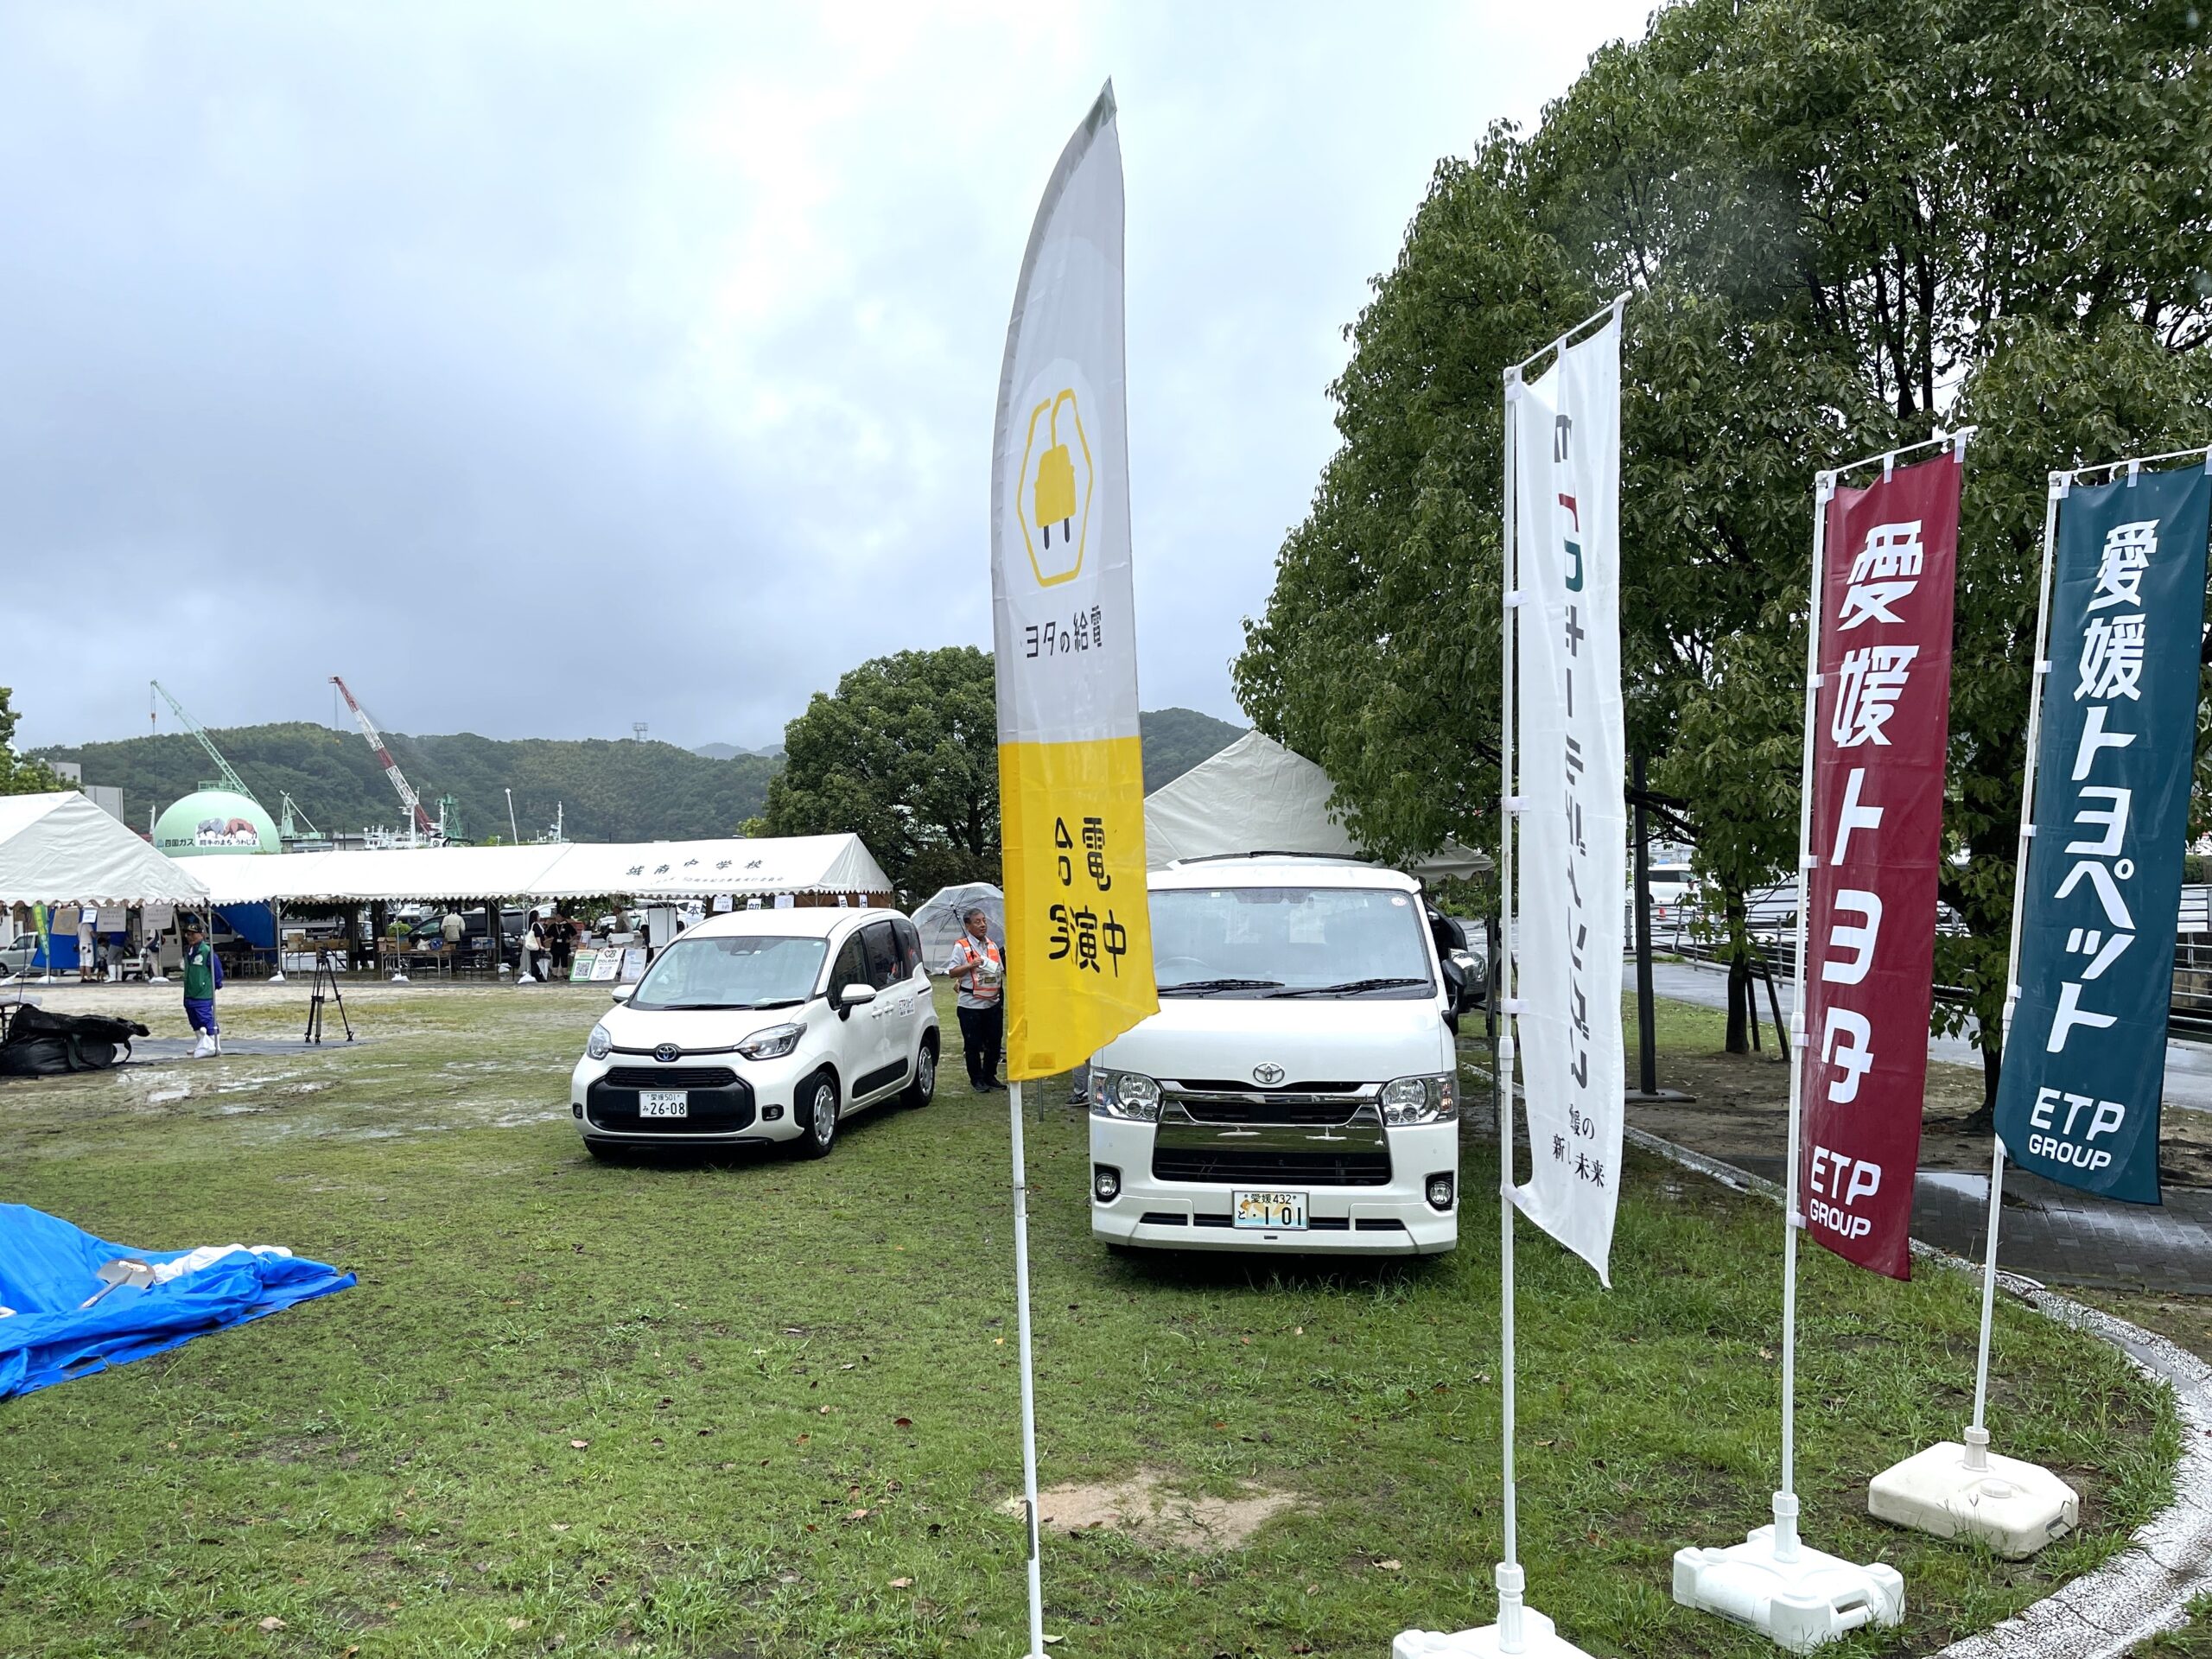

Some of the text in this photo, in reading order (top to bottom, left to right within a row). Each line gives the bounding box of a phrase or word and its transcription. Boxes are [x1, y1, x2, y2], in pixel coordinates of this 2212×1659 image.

[1025, 605, 1102, 658] ヨタの給電
[1821, 519, 1923, 1103] 愛媛トヨタ
[2047, 519, 2160, 1053] 愛媛トヨペット
[650, 1102, 685, 1115] 26-08
[2030, 1086, 2126, 1141] ETP
[1553, 1133, 1605, 1188] 新し未来
[1810, 1145, 1882, 1206] ETP
[2028, 1134, 2112, 1171] GROUP
[1237, 1210, 1246, 1220] と
[1809, 1198, 1872, 1240] GROUP
